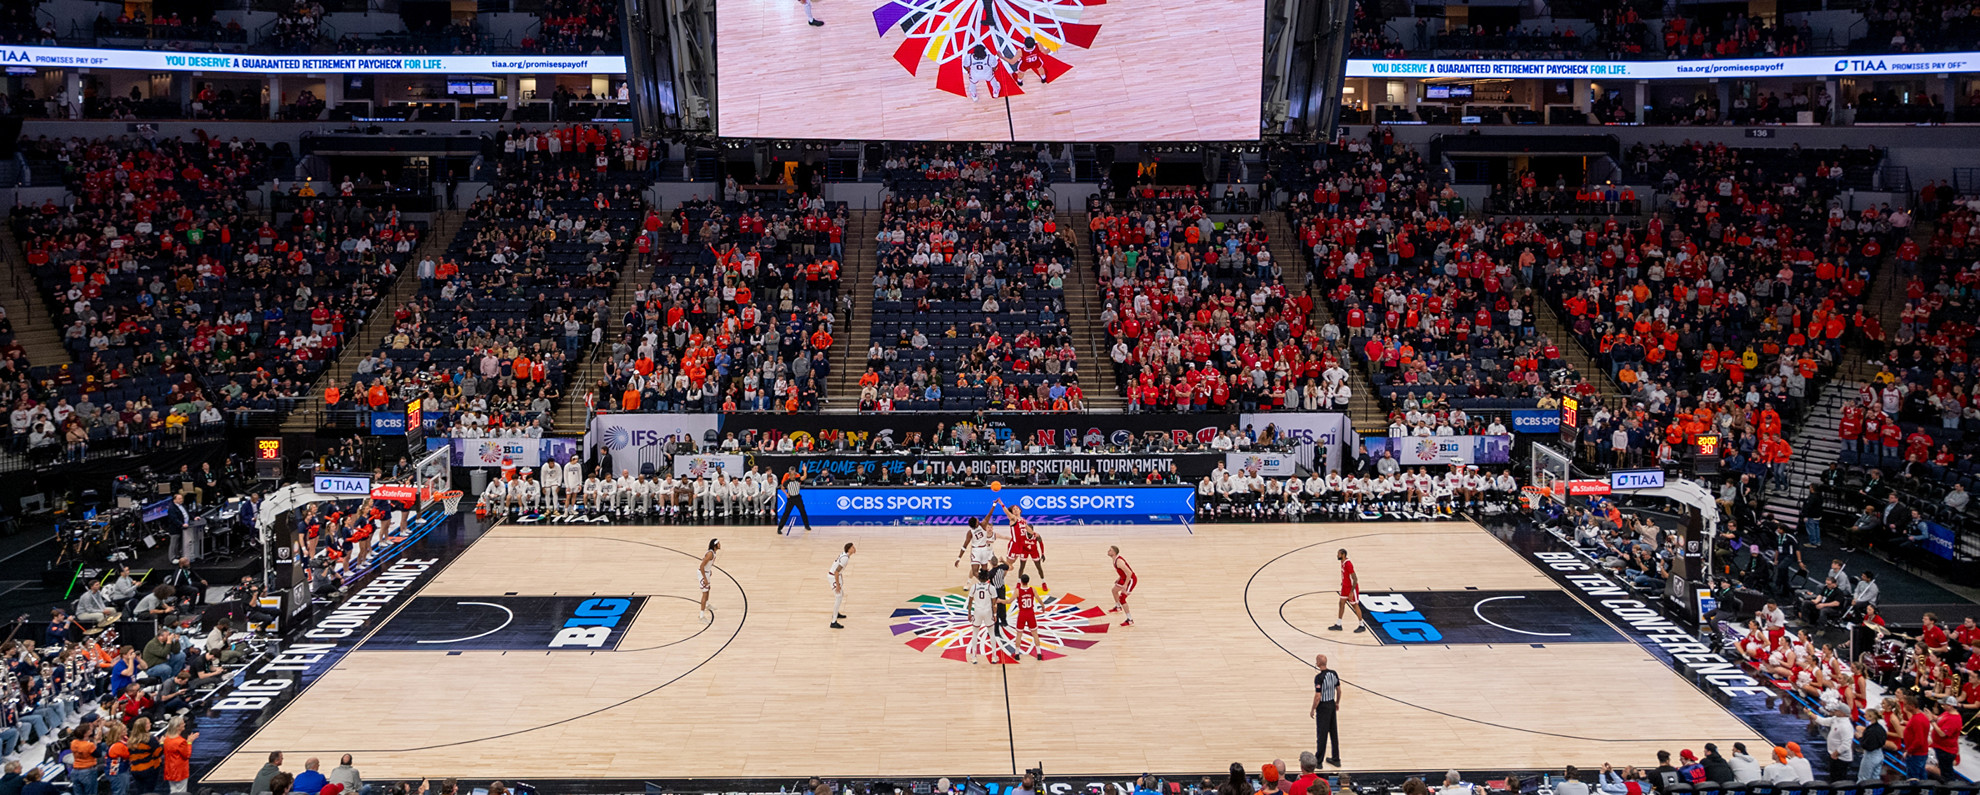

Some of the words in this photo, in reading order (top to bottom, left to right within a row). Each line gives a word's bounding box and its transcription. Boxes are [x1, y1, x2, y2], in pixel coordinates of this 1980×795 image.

[0, 50, 31, 62] IAA
[36, 56, 74, 64] PROMISES
[165, 56, 186, 66] YOU
[188, 56, 230, 68] DESERVE
[233, 59, 240, 68] A
[242, 58, 300, 69] GUARANTEED
[302, 60, 356, 70] RETIREMENT
[358, 60, 402, 70] PAYCHECK
[404, 60, 421, 69] FOR
[492, 60, 588, 70] tiaa.org/promisespayoff
[1676, 62, 1784, 74] tiaa.org/promisespayoff
[1851, 60, 1887, 71] TIAA
[1892, 62, 1930, 70] PROMISES
[1932, 62, 1946, 70] PAY
[1372, 64, 1389, 73] YOU
[1391, 64, 1428, 74] DESERVE
[1429, 64, 1436, 73] A
[1437, 64, 1491, 74] GUARANTEED
[1493, 64, 1544, 74] RETIREMENT
[1546, 64, 1588, 75] PAYCHECK
[1590, 65, 1606, 75] FOR
[408, 409, 420, 431] 30
[1523, 417, 1540, 426] CBS
[1542, 417, 1560, 426] SPO
[1563, 406, 1576, 428] 30
[383, 419, 402, 428] CBS
[1037, 429, 1056, 447] N
[1196, 426, 1218, 444] W
[263, 448, 275, 458] 30
[1702, 444, 1713, 454] 30
[799, 460, 857, 474] WELCOME
[860, 460, 878, 473] TO
[931, 461, 968, 475] TIAA
[972, 460, 992, 474] BIG
[993, 460, 1016, 474] TEN
[1020, 459, 1090, 474] BASKETBALL
[1096, 458, 1173, 473] TOURNAMENT
[334, 480, 364, 491] TIAA
[1630, 475, 1658, 486] TIAA
[851, 496, 884, 510] CBS
[886, 496, 952, 510] SPORTS
[1034, 496, 1066, 509] CBS
[1070, 496, 1134, 509] SPORTS
[551, 514, 610, 522] TIAA
[974, 531, 984, 540] 13
[978, 590, 984, 600] 0
[1021, 598, 1032, 608] 30
[1534, 552, 1590, 571] BIG
[1565, 573, 1629, 596] TEN
[1600, 599, 1778, 697] CONFERENCE
[211, 678, 293, 710] BIG
[257, 644, 338, 674] TEN
[304, 558, 439, 638] CONFERENCE
